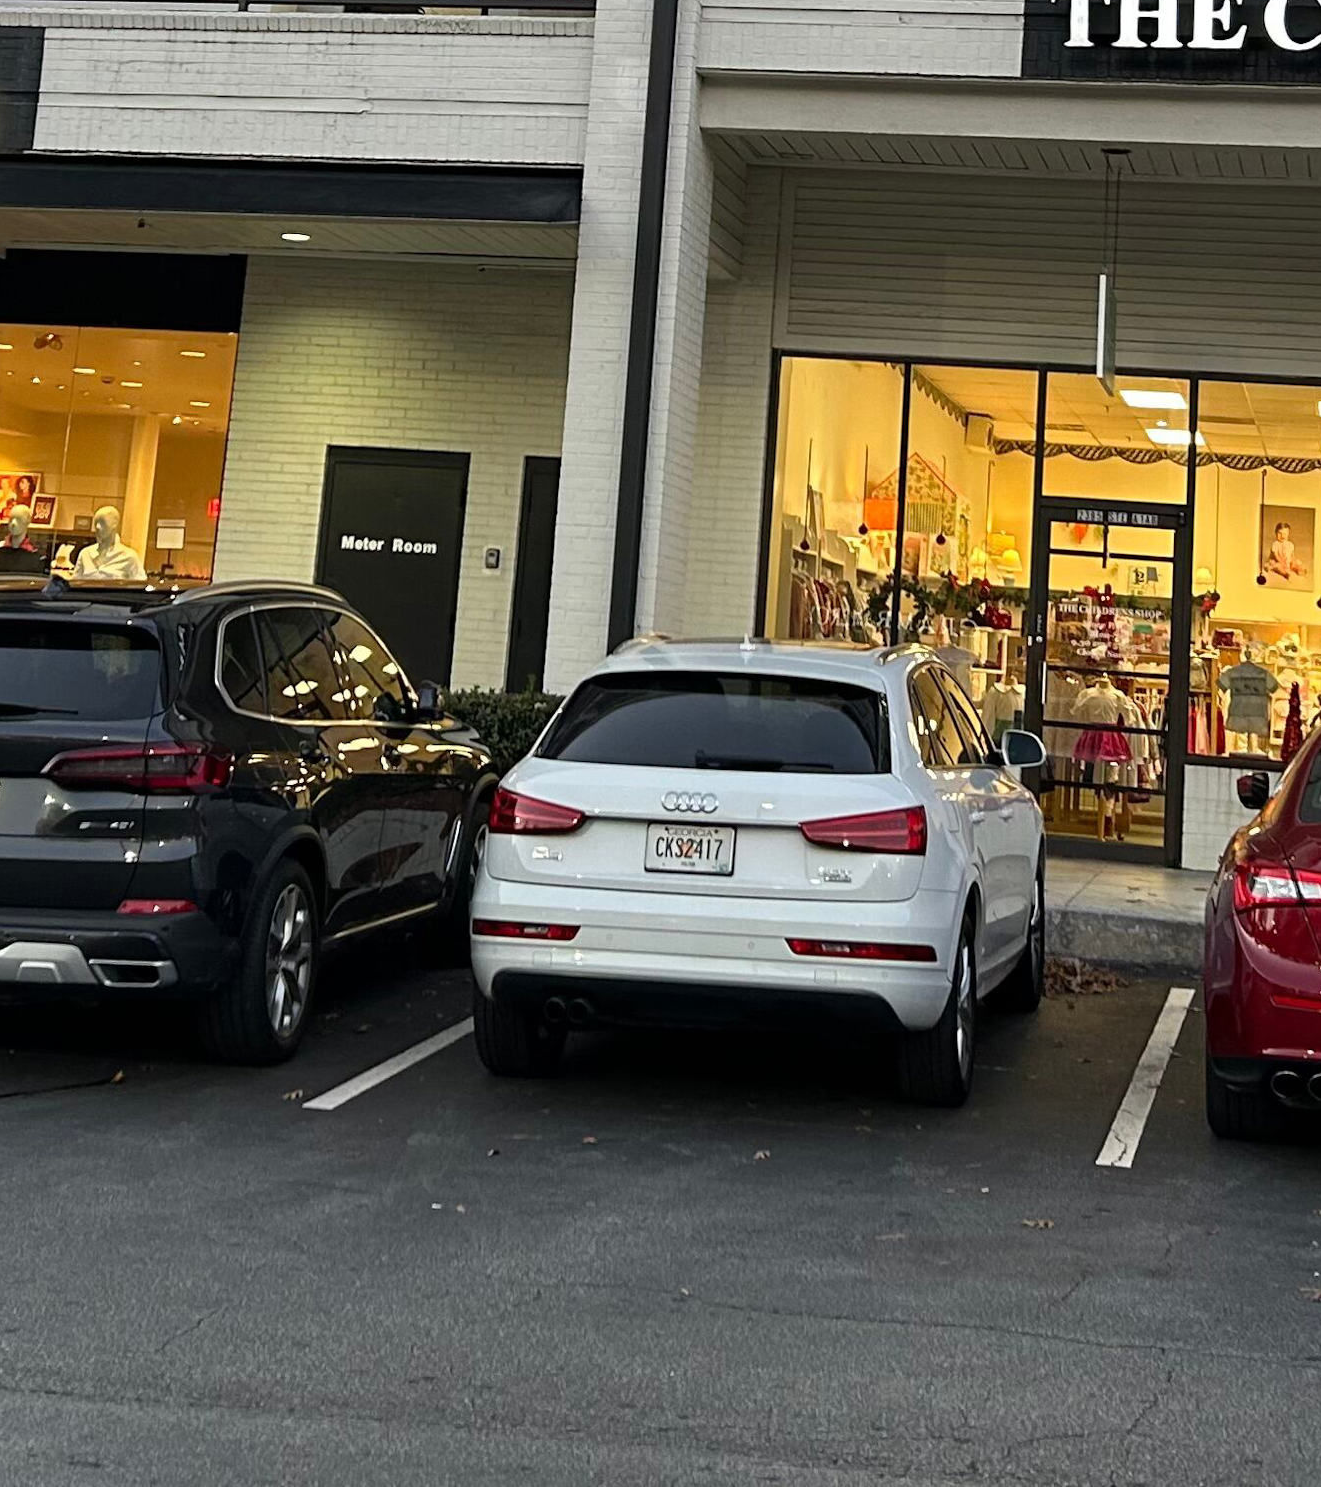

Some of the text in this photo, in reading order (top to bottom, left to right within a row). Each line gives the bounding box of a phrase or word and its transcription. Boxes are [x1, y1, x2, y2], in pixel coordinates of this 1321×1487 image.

[341, 535, 437, 554] Meter Room
[656, 836, 723, 861] CKS2417
